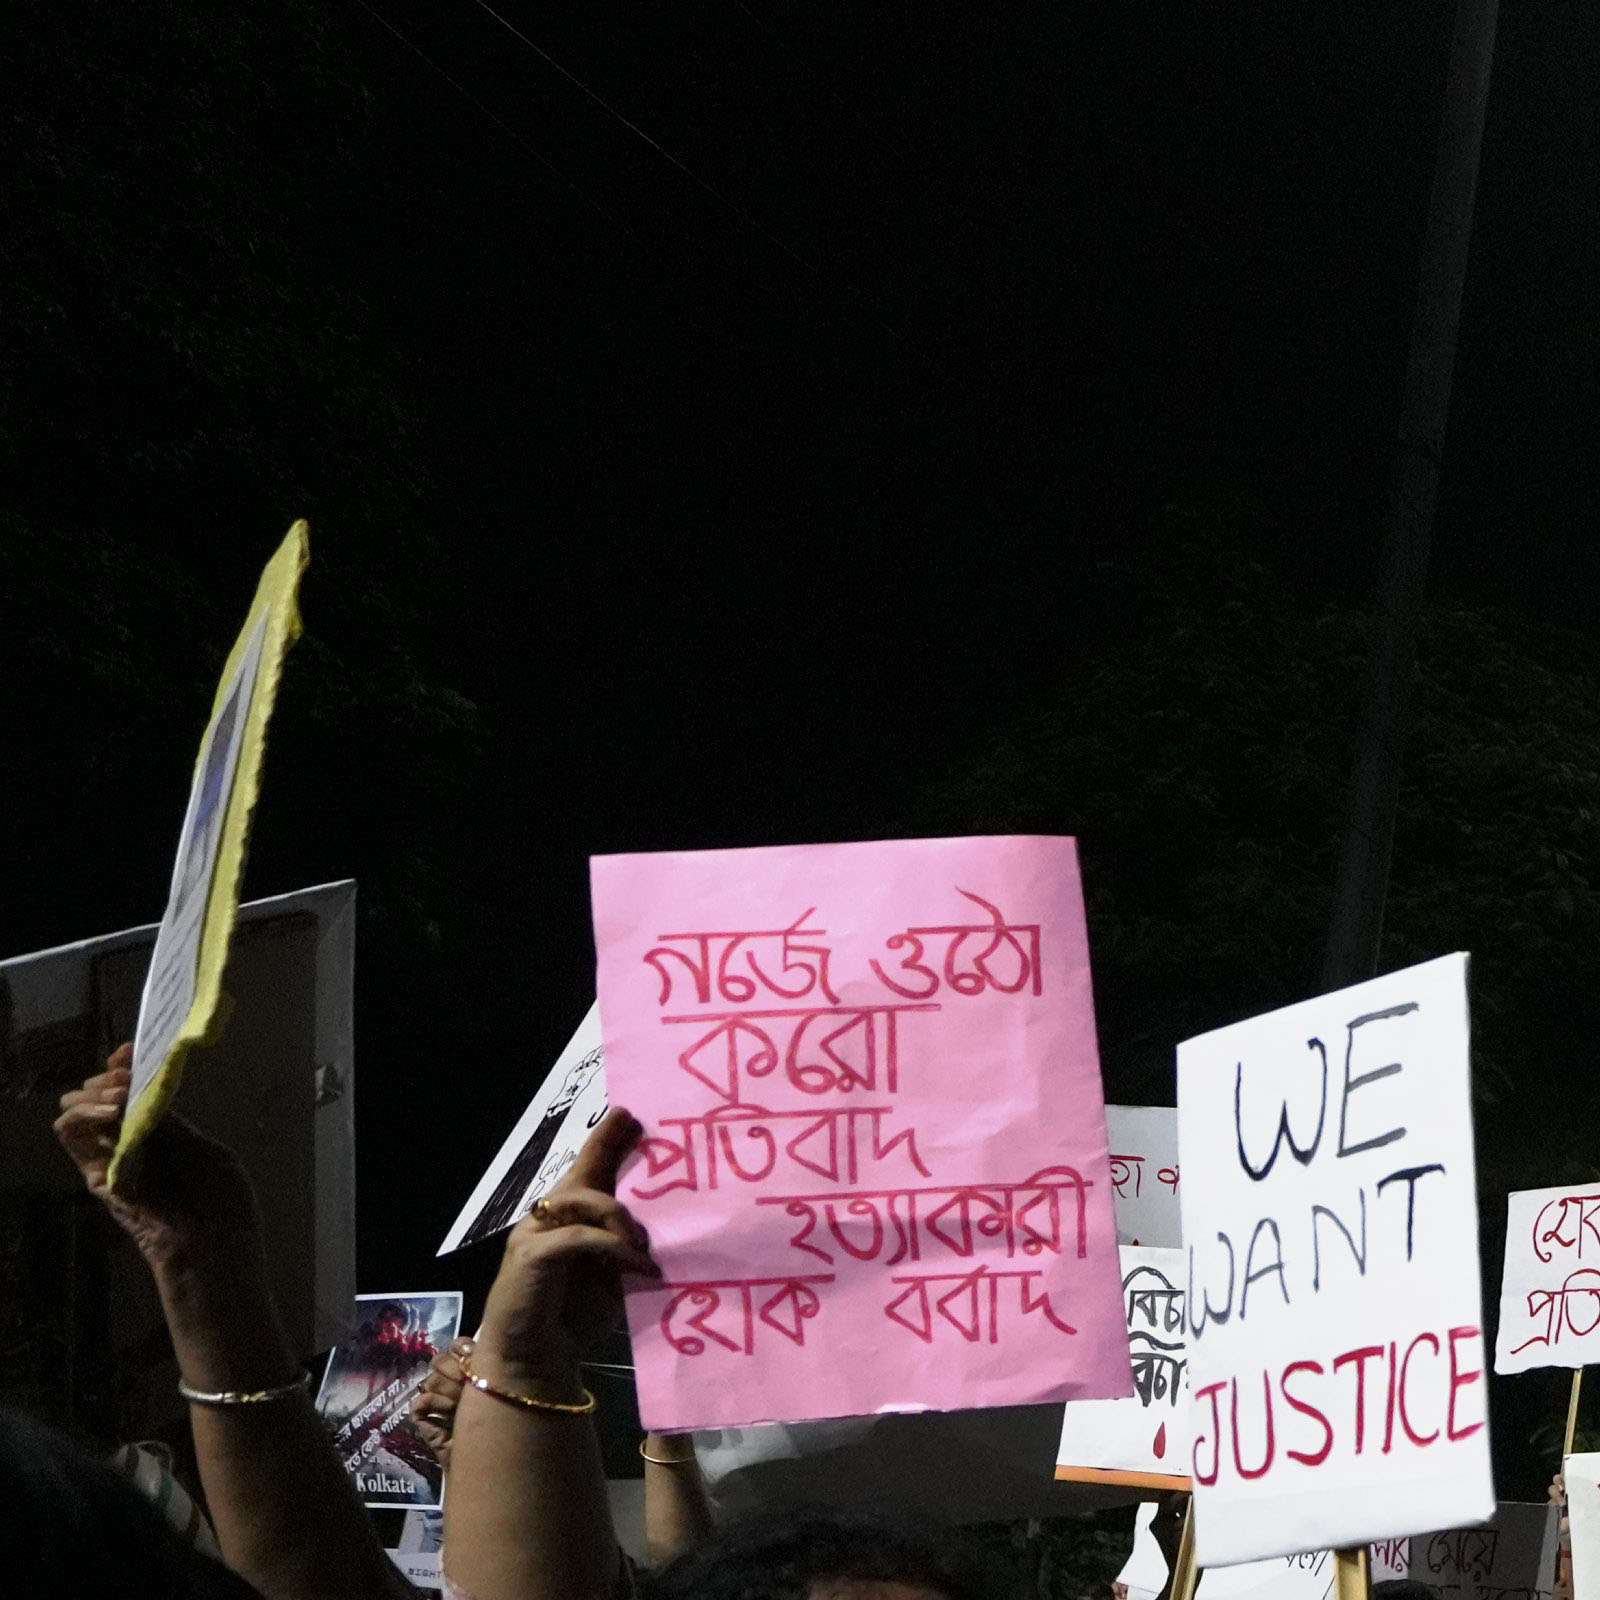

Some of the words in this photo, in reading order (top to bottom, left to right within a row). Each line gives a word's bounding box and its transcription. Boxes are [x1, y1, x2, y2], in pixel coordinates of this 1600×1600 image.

[643, 907, 839, 1005] গর্জে
[869, 886, 1042, 999] ওঠো
[661, 1003, 940, 1105] করো
[1236, 1002, 1420, 1181] WE
[631, 1103, 931, 1198] প্রতিবাদ
[757, 1165, 1092, 1266] হত্যাকারী
[1189, 1165, 1446, 1339] WANT
[660, 1275, 835, 1355] হোক
[1123, 1265, 1185, 1335] বিচা
[1192, 1325, 1486, 1487] JUSTICE
[356, 1473, 415, 1494] Kolkata
